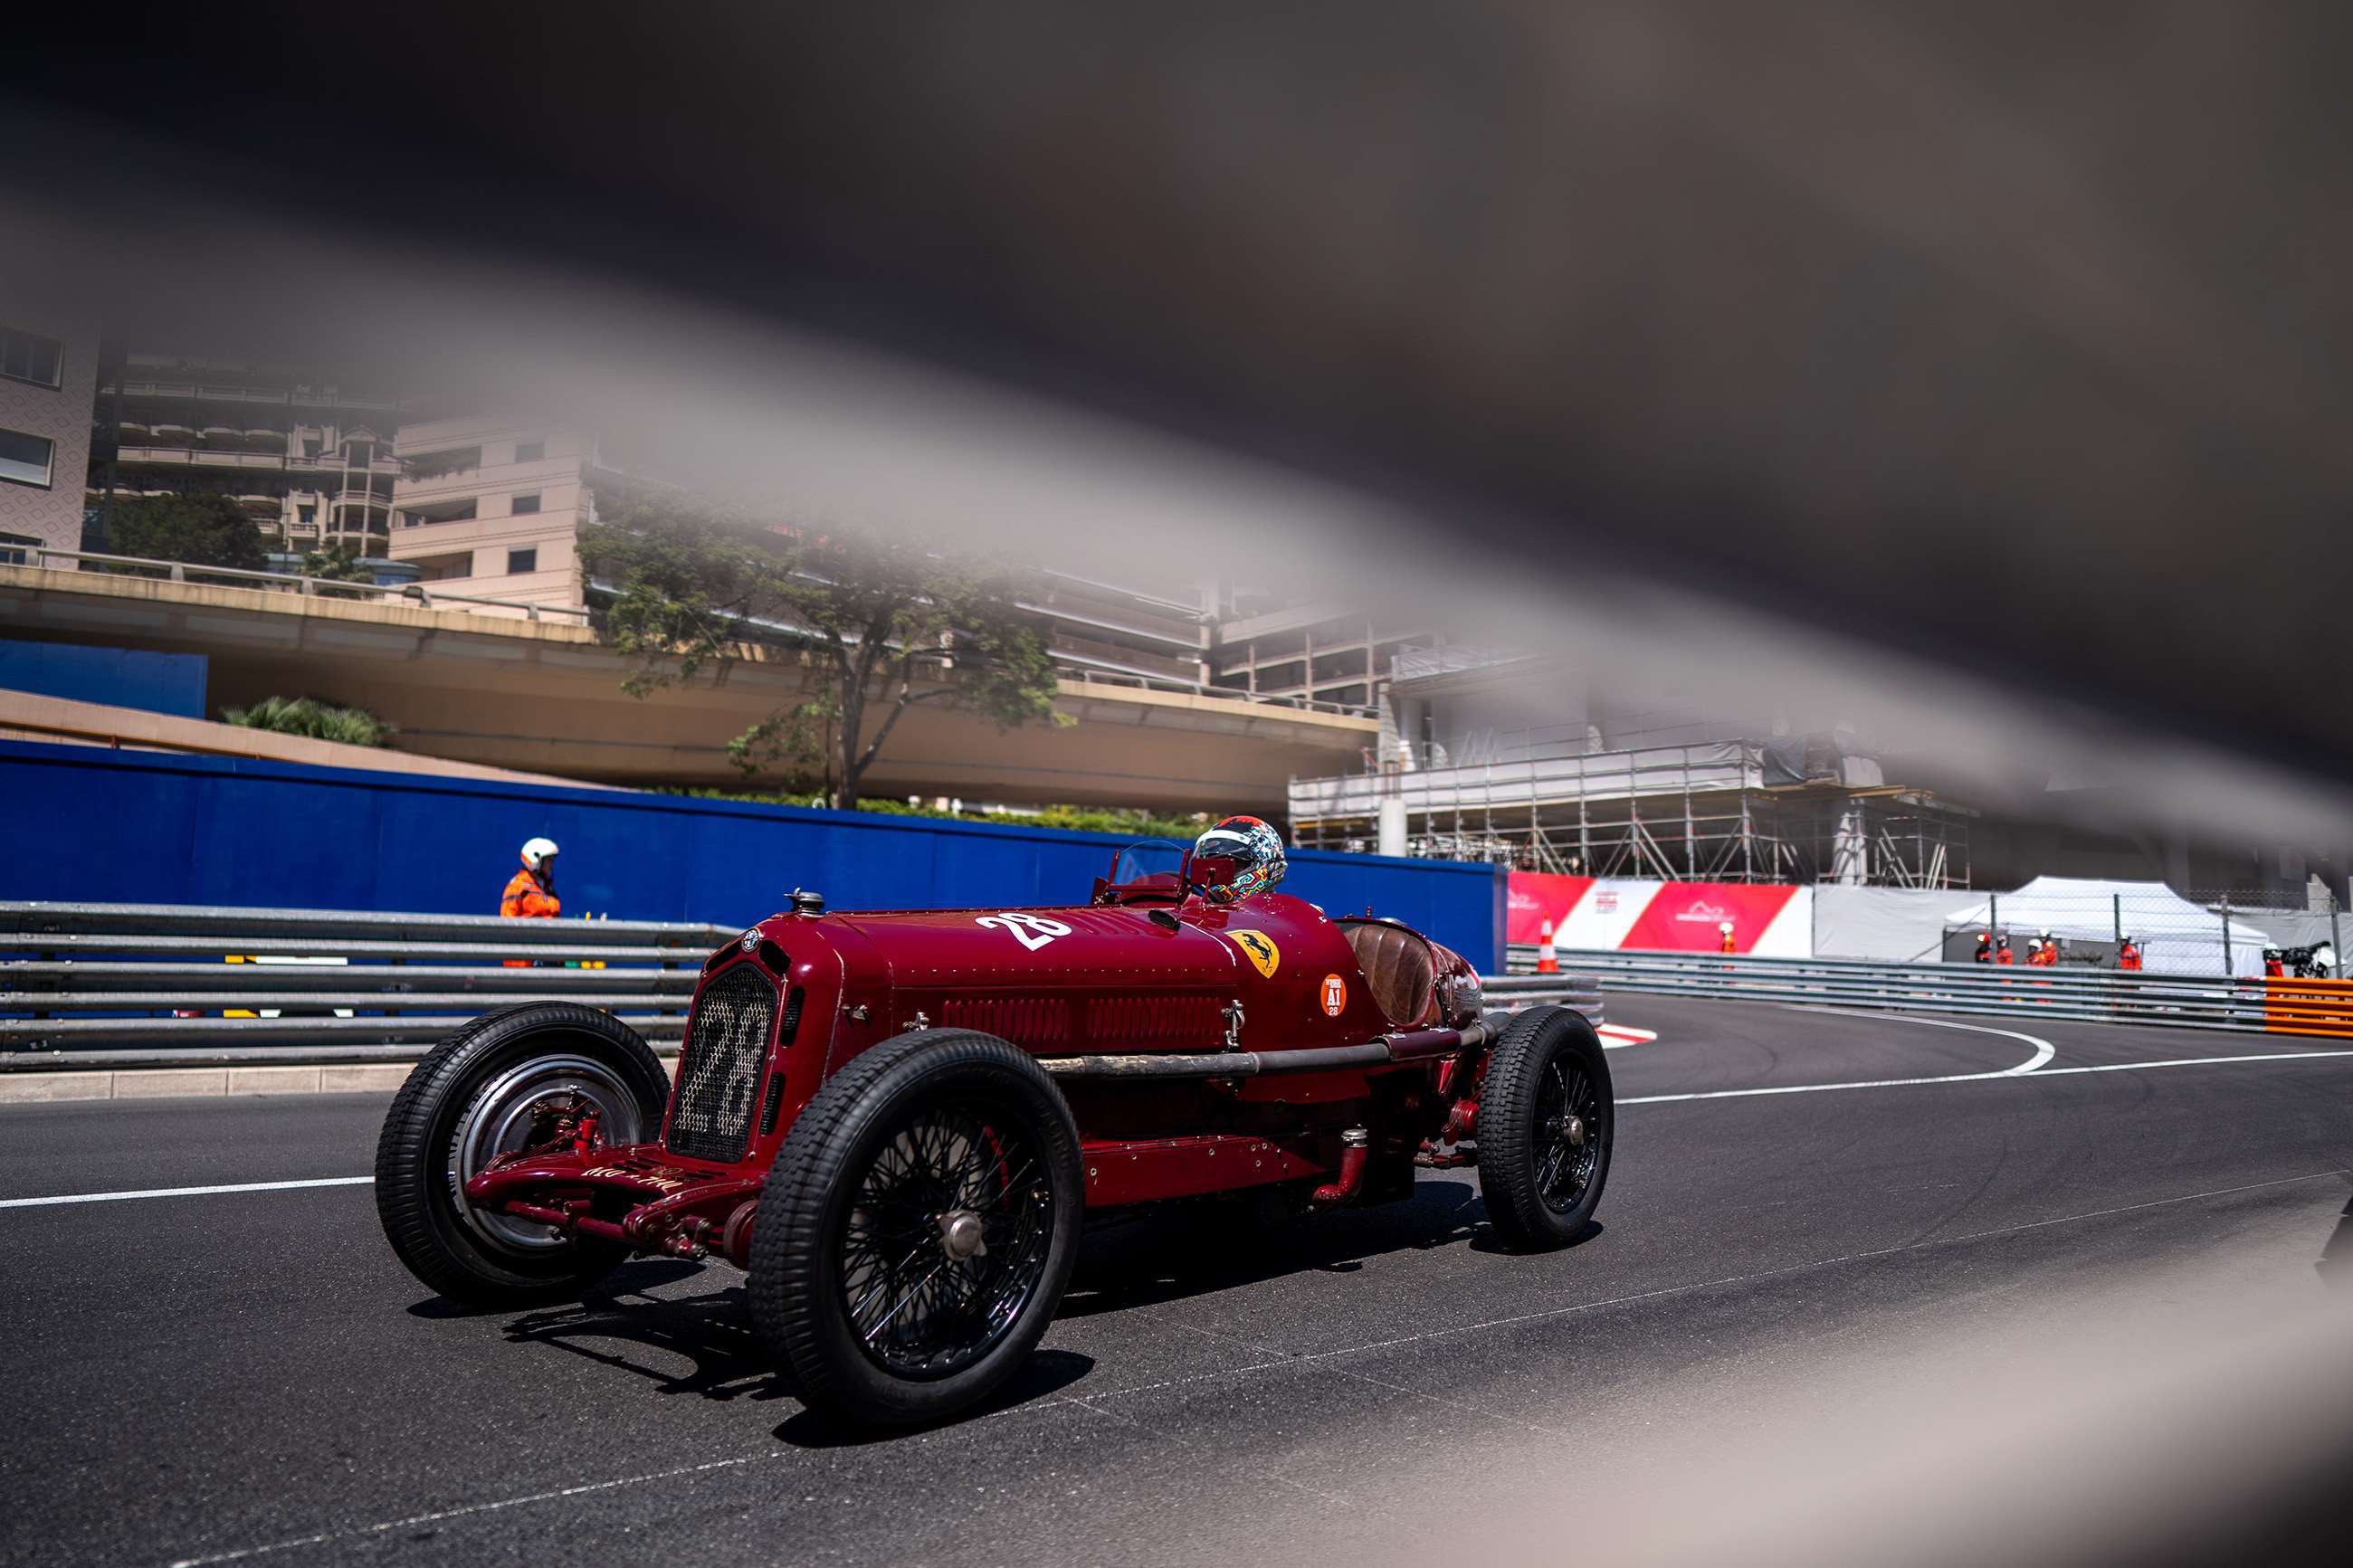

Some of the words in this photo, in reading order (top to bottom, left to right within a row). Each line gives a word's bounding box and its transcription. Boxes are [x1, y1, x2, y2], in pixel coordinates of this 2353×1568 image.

[975, 912, 1072, 951] 28
[1327, 988, 1340, 1006] A1
[1329, 1006, 1338, 1014] 28
[675, 1002, 769, 1136] 28
